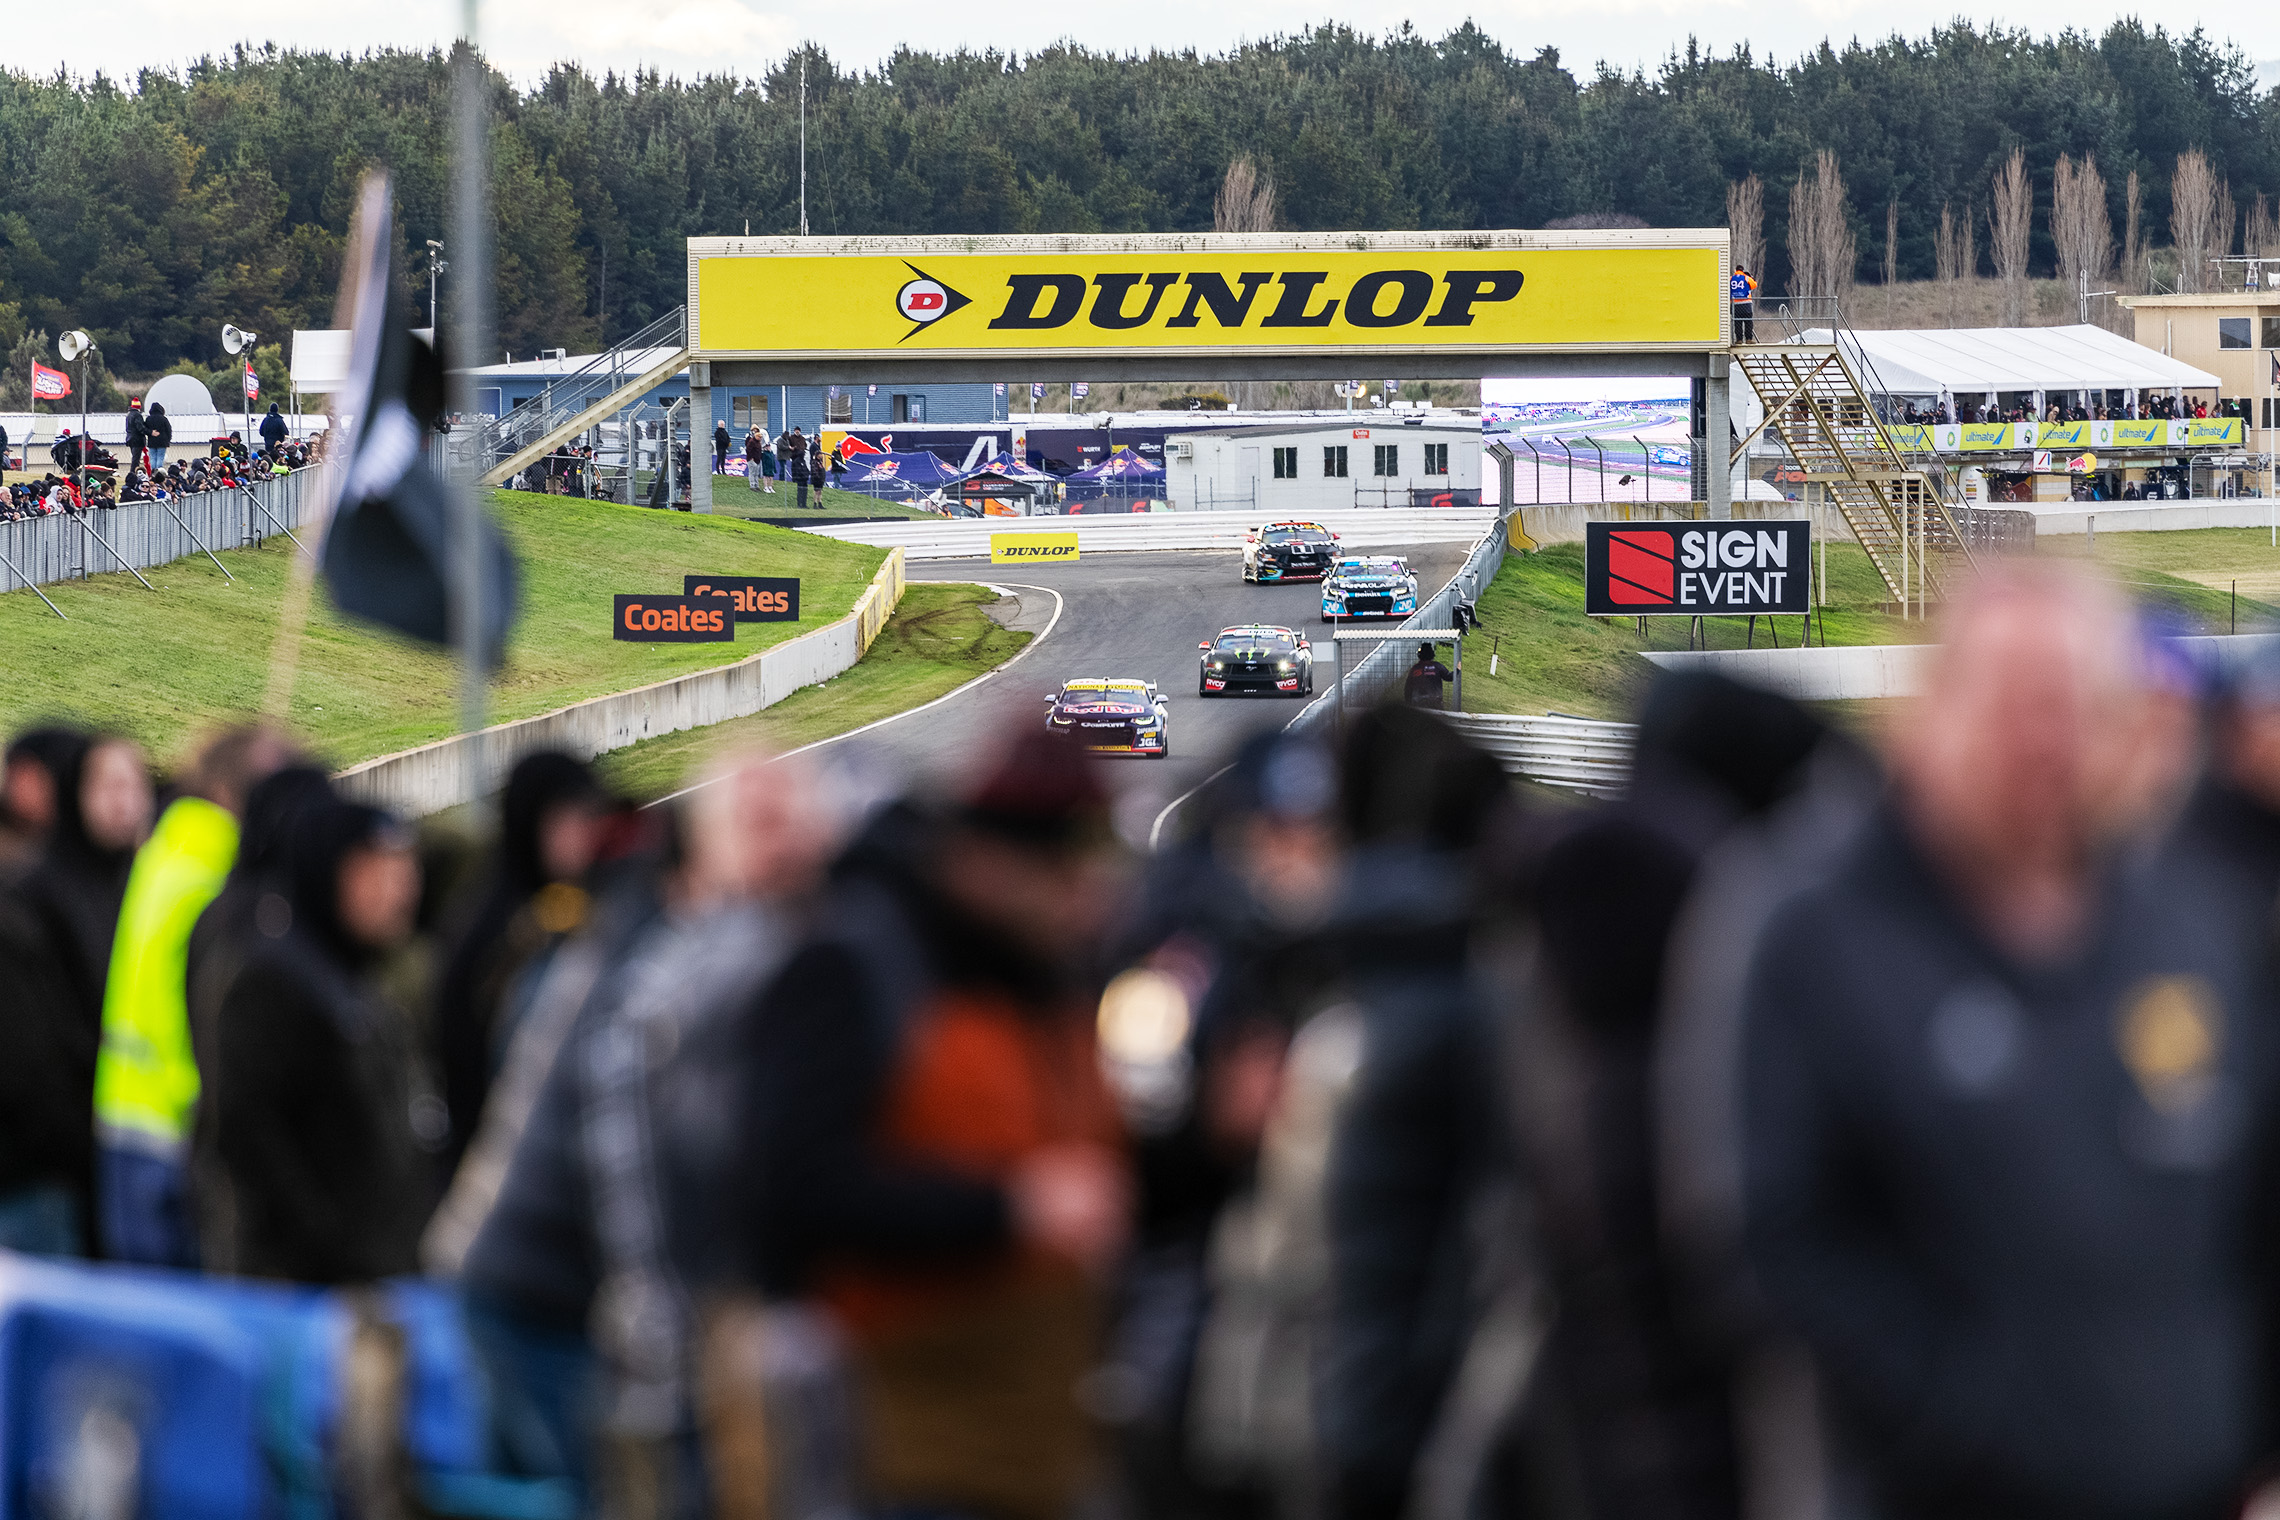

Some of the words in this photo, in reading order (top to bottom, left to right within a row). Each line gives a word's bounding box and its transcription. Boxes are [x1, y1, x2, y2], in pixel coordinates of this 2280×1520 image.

[1731, 280, 1744, 290] 94
[987, 270, 1525, 330] DUNLOP
[1965, 431, 1995, 442] ultimate
[2043, 429, 2072, 440] ultimate
[2118, 428, 2147, 439] ultimate
[2193, 425, 2222, 437] ultimate
[1004, 547, 1076, 556] DUNLOP
[1681, 530, 1788, 568] SIGN
[1681, 572, 1788, 604] EVENT
[694, 585, 788, 612] ates
[624, 604, 724, 632] Coates
[1206, 680, 1224, 688] RYCO
[1063, 705, 1104, 714] Red
[1105, 705, 1144, 714] Bull
